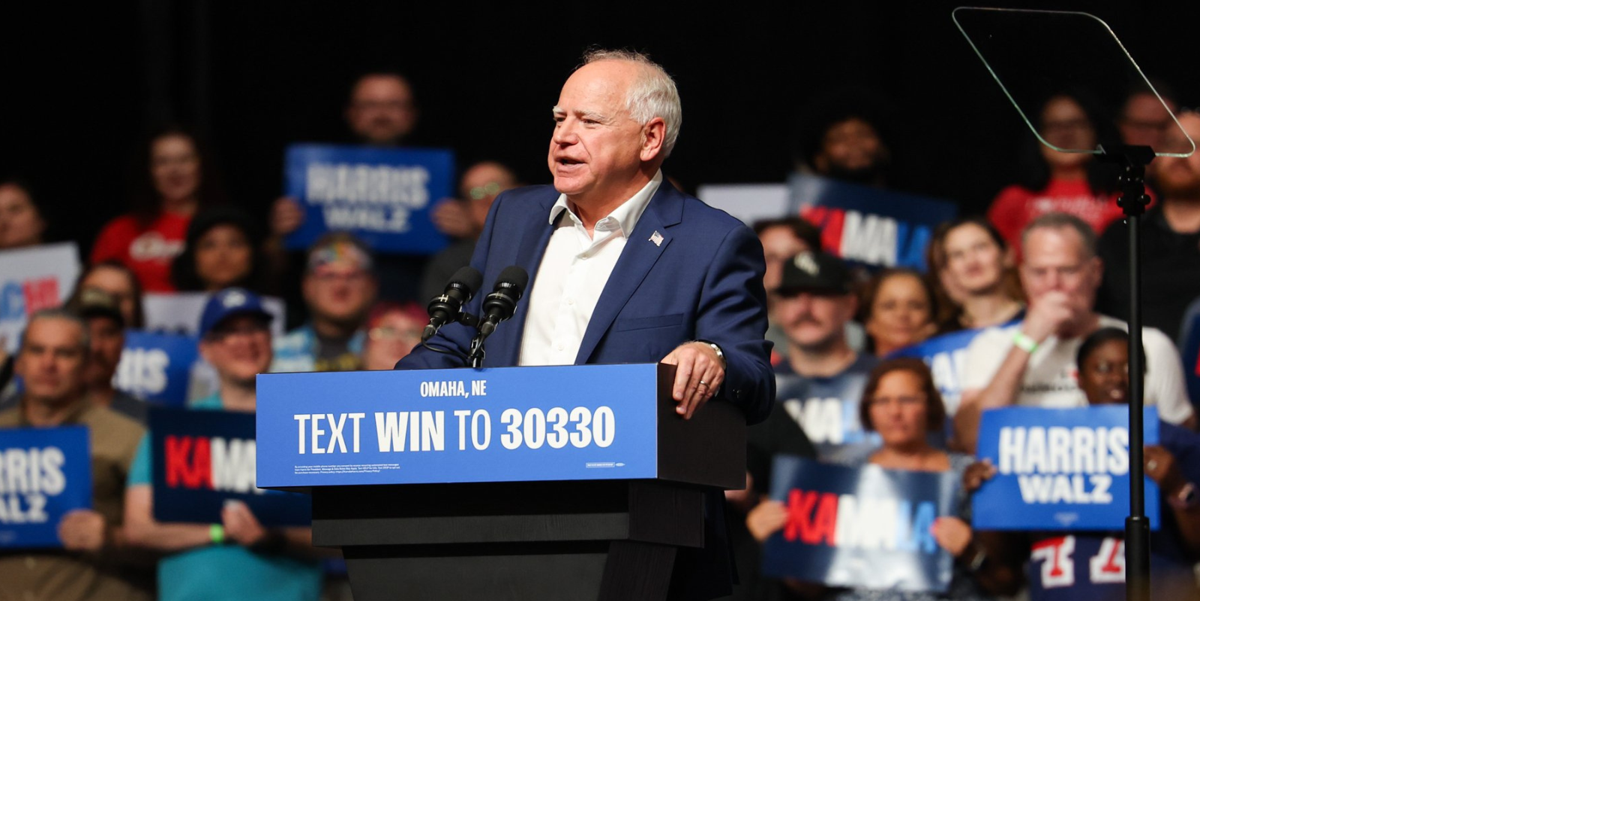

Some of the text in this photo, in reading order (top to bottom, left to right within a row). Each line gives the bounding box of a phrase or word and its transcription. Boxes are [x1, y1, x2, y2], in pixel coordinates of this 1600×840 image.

[420, 380, 487, 399] OMAHA, NE
[294, 405, 616, 454] TEXT WIN TO 30330
[999, 426, 1129, 476] HARRIS
[1018, 474, 1113, 504] WALZ
[784, 488, 937, 555] KAMALA
